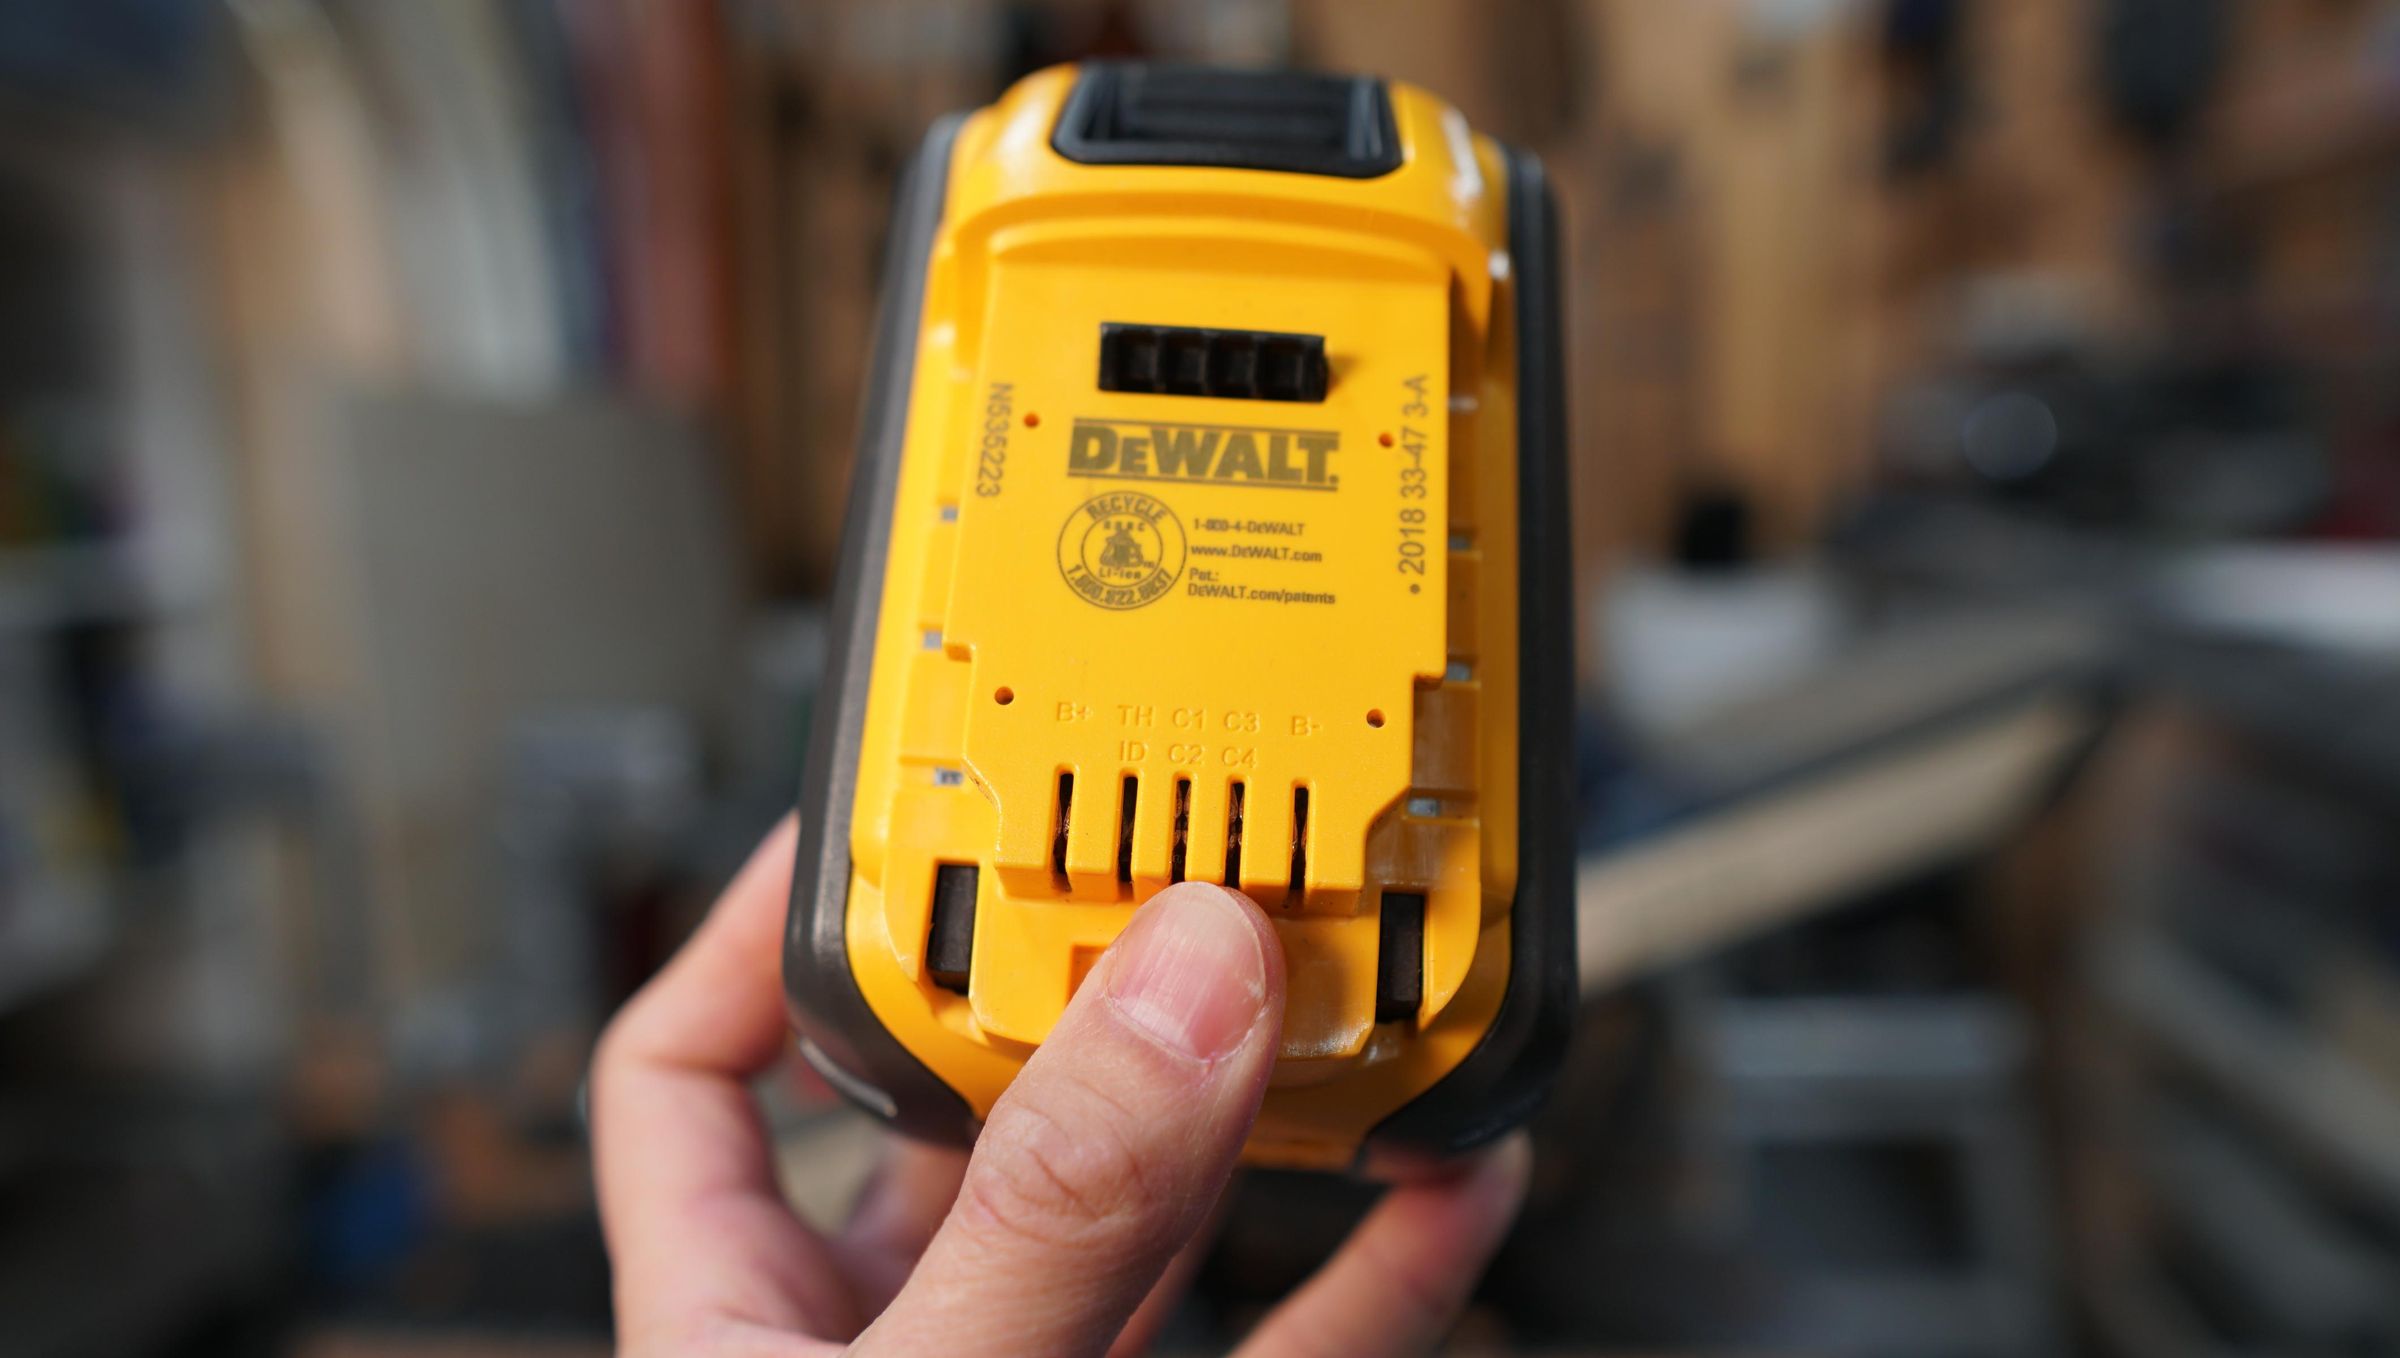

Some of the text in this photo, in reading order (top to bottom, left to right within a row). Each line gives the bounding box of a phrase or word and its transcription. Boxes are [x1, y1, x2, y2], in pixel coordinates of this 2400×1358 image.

[975, 382, 1014, 498] N535223
[1398, 374, 1429, 576] 2018 33-47 3-A
[1086, 495, 1167, 525] RECYCLE
[1056, 701, 1323, 737] B+ TH C1 C3 B-
[1119, 740, 1258, 769] ID C2 C4
